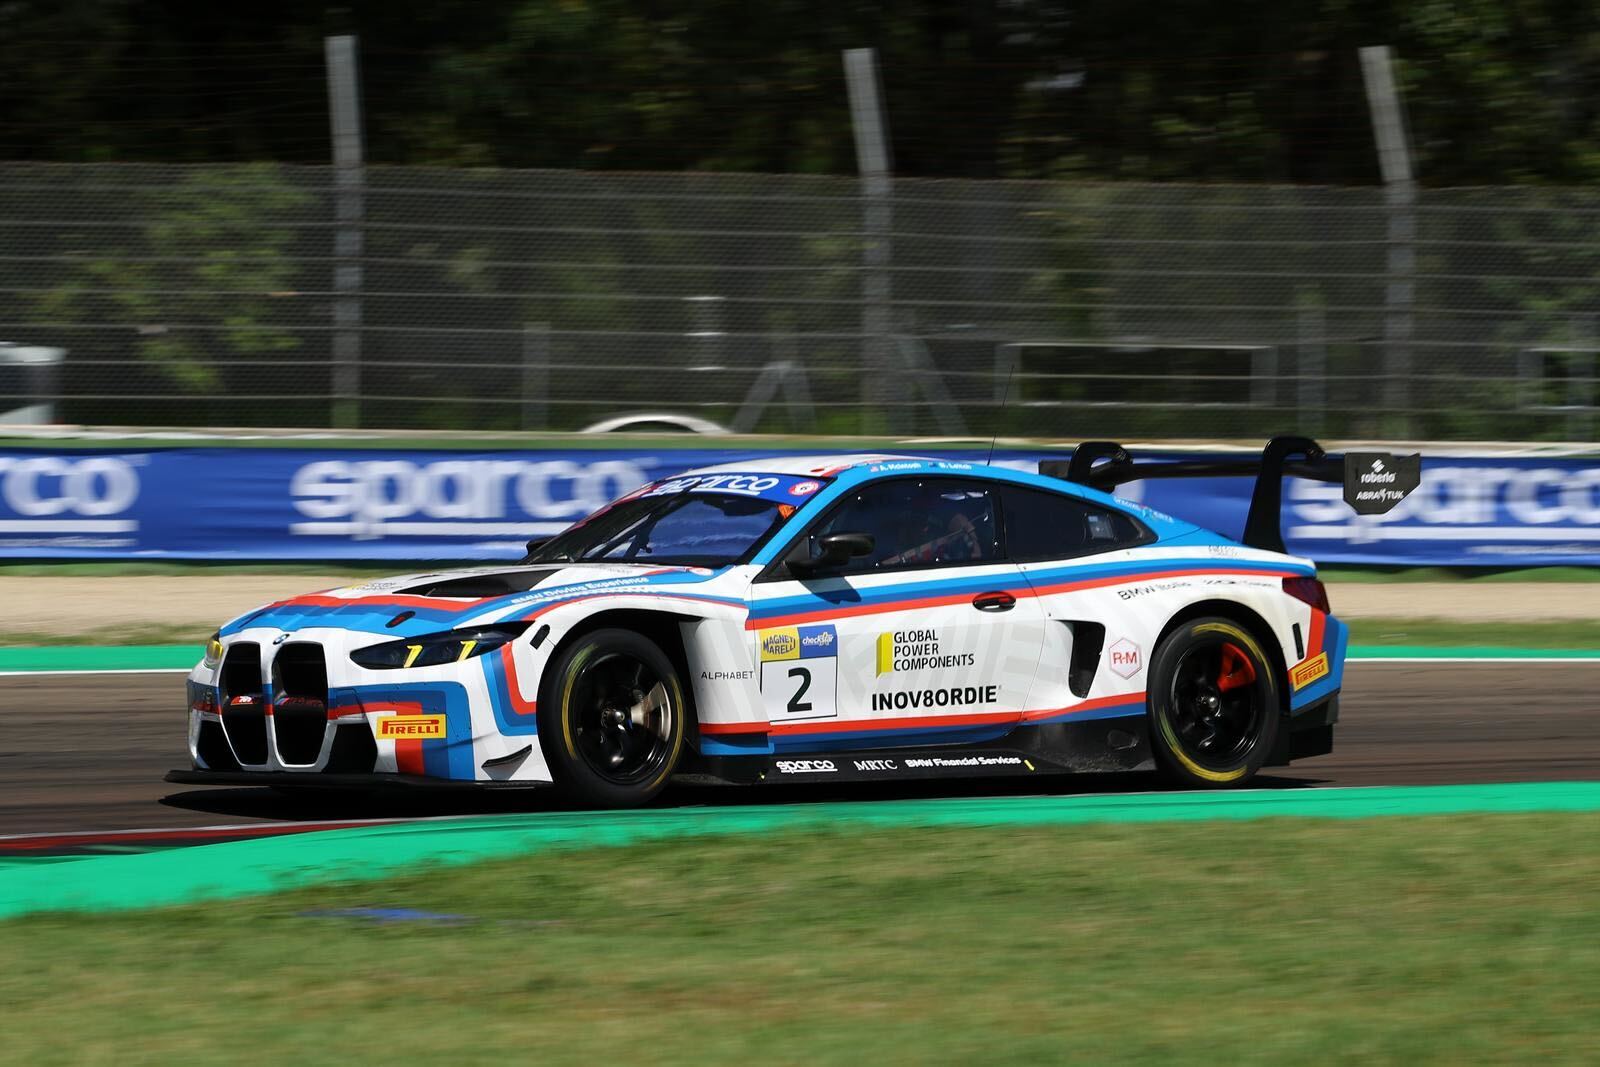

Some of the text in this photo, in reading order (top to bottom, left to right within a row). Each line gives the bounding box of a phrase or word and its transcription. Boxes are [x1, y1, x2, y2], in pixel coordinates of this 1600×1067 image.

[652, 475, 779, 496] sparco
[290, 459, 650, 540] sparco
[543, 585, 586, 598] Driving
[585, 577, 649, 591] Experience
[1117, 585, 1156, 600] BMW
[894, 629, 939, 644] GLOBAL
[894, 643, 939, 658] POWER
[894, 653, 975, 672] COMPONENTS
[701, 670, 754, 680] ALPHABET
[1295, 658, 1325, 686] PIRELLI
[787, 667, 812, 713] 2
[872, 685, 997, 711] INOV8ORDIE
[382, 719, 440, 735] PIRELLI
[776, 760, 838, 774] sparco
[853, 759, 898, 771] MRTC
[905, 756, 1021, 768] BMW Financial Services
